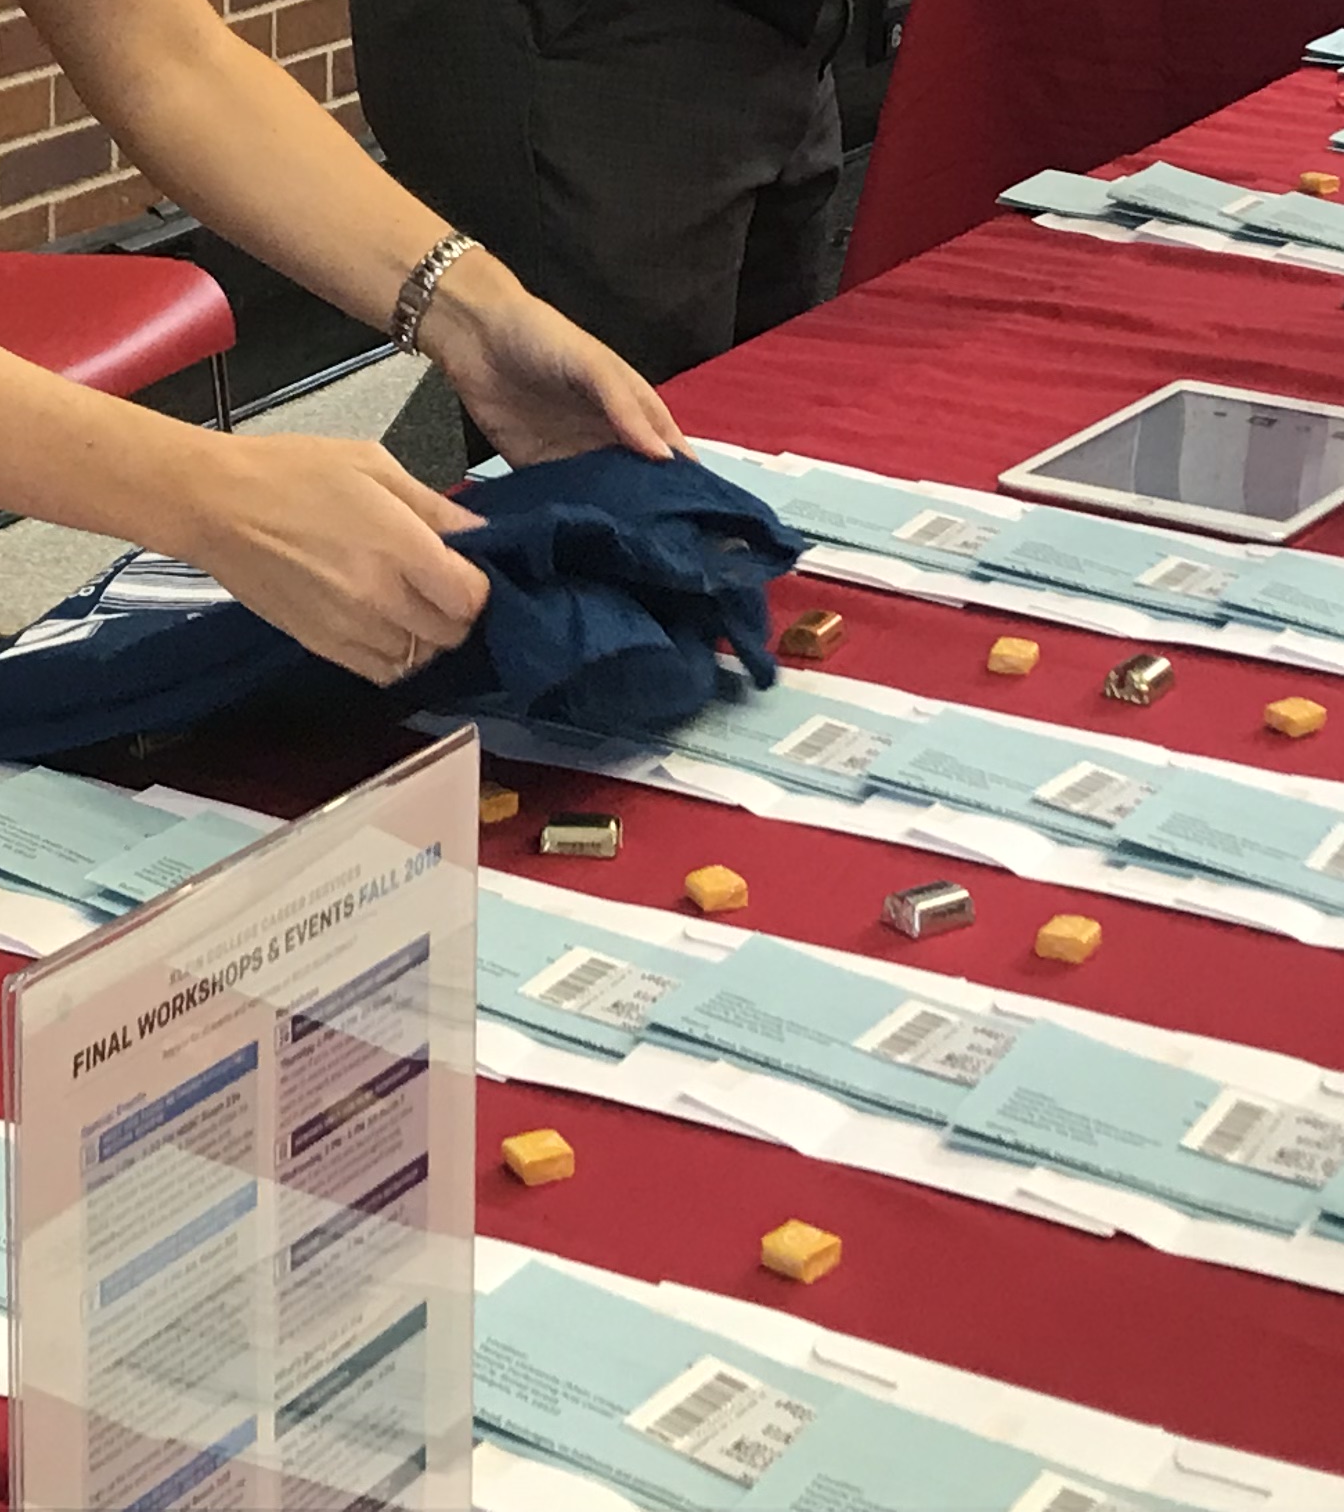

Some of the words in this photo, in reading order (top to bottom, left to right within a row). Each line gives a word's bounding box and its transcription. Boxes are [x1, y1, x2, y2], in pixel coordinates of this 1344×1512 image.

[72, 1025, 133, 1079] FINAL
[137, 946, 263, 1040] WORKSHOPS
[267, 935, 280, 964] &
[284, 892, 355, 954] EVENTS
[359, 868, 400, 909] FALL
[404, 840, 442, 885] 2018
